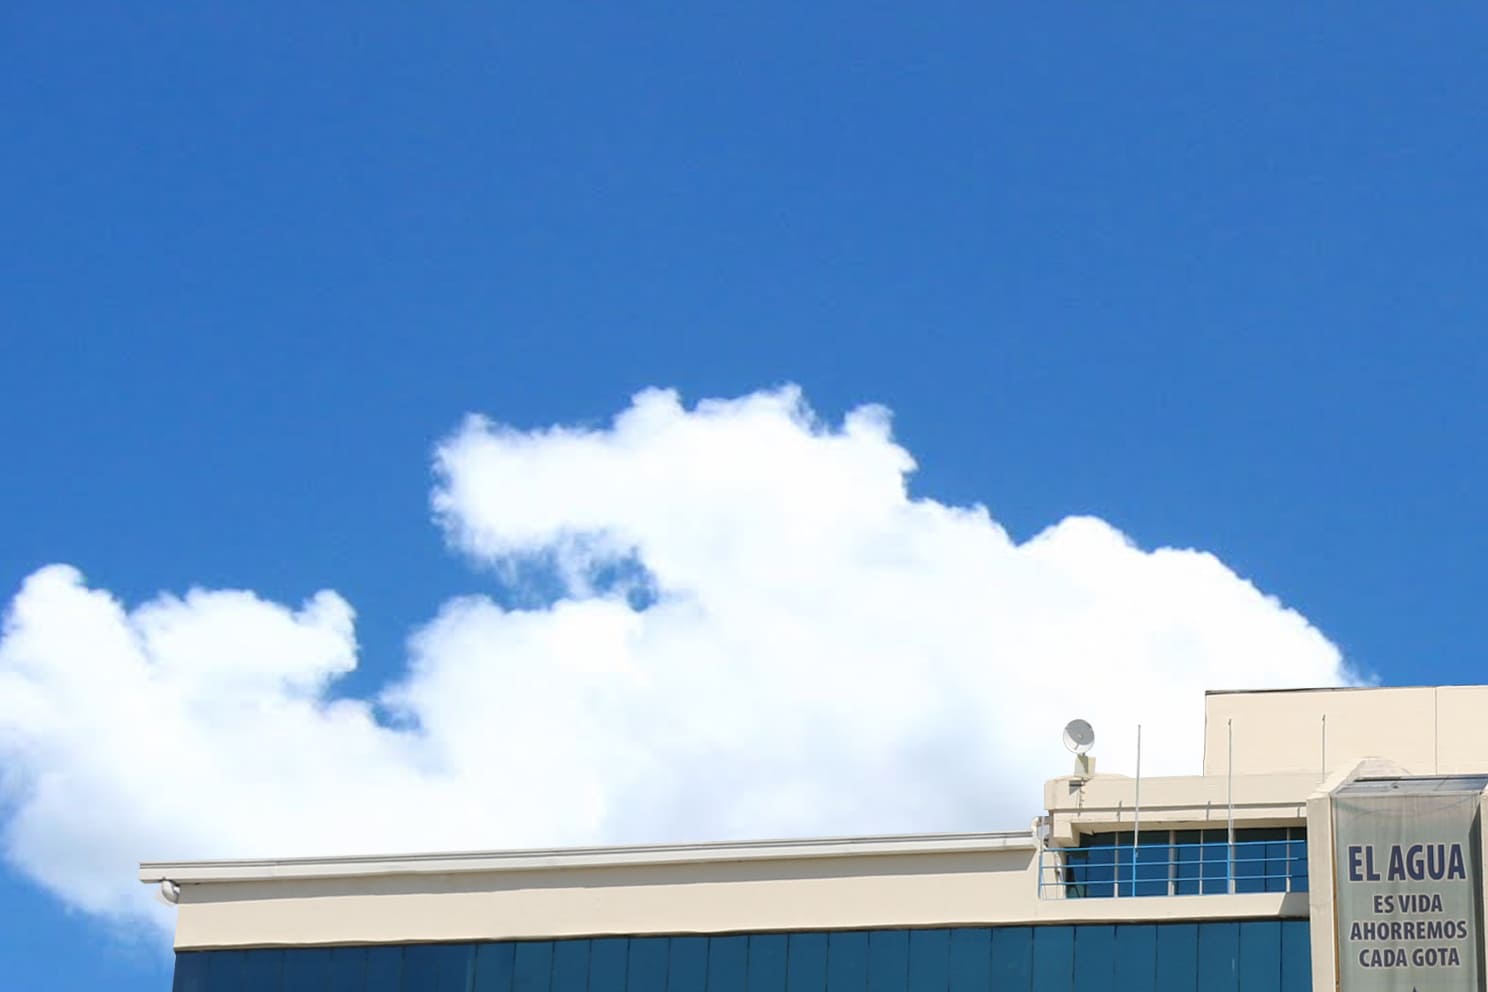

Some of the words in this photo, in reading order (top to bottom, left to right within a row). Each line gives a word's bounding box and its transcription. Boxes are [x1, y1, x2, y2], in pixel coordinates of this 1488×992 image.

[1349, 846, 1380, 881] EL
[1388, 844, 1466, 880] AGUA
[1374, 895, 1394, 913] ES
[1398, 894, 1443, 912] VIDA
[1350, 921, 1467, 940] AHORREMOS
[1359, 949, 1407, 967] CADA
[1412, 948, 1460, 966] GOTA
